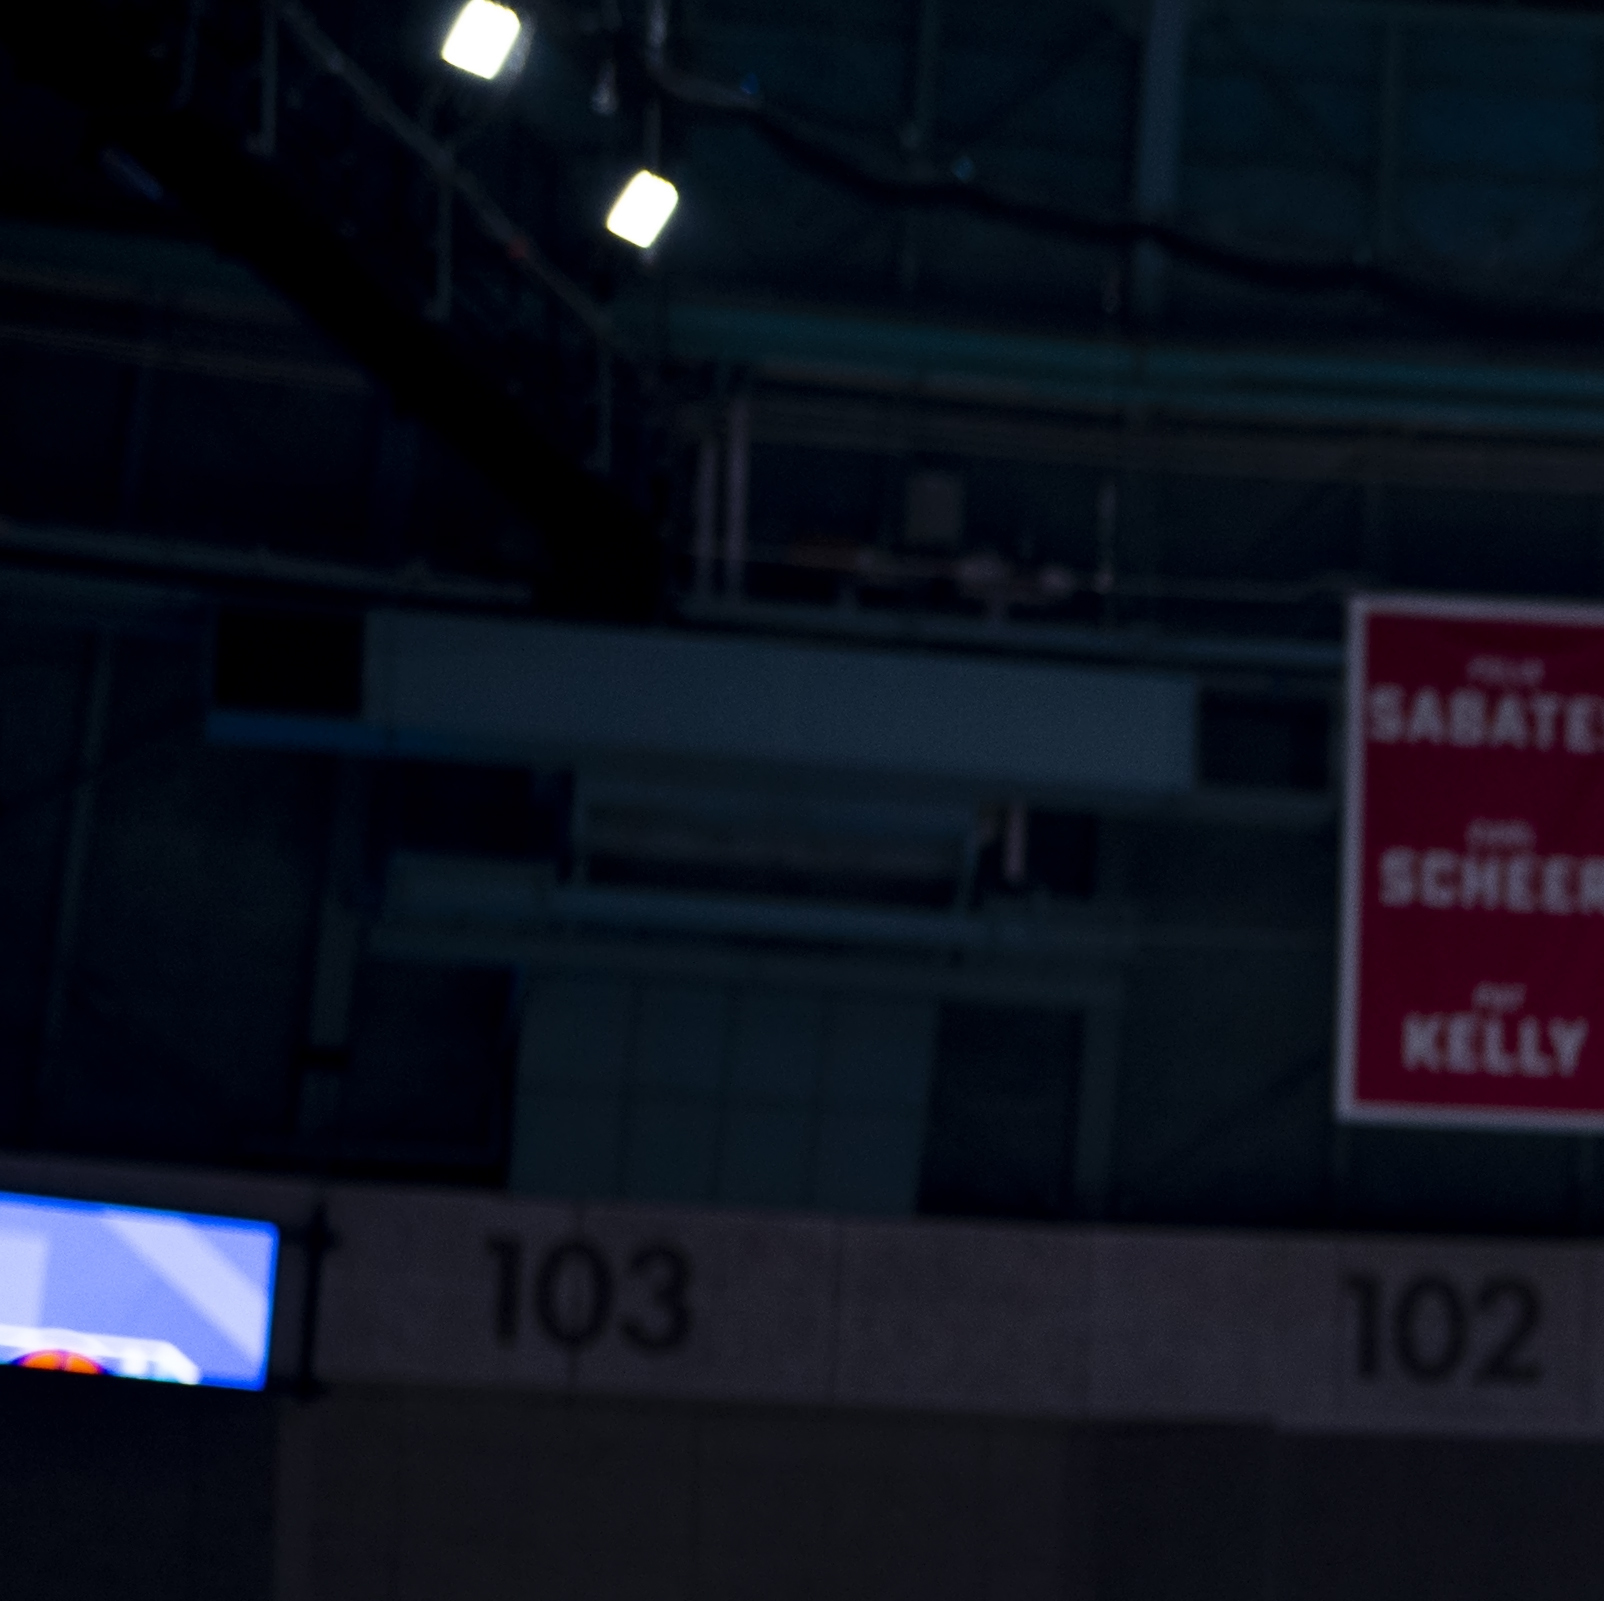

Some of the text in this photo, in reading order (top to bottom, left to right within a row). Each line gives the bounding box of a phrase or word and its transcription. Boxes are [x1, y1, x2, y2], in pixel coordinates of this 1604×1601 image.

[1400, 1009, 1591, 1078] KELLY
[487, 1230, 693, 1352] 103
[1344, 1275, 1544, 1386] 102
